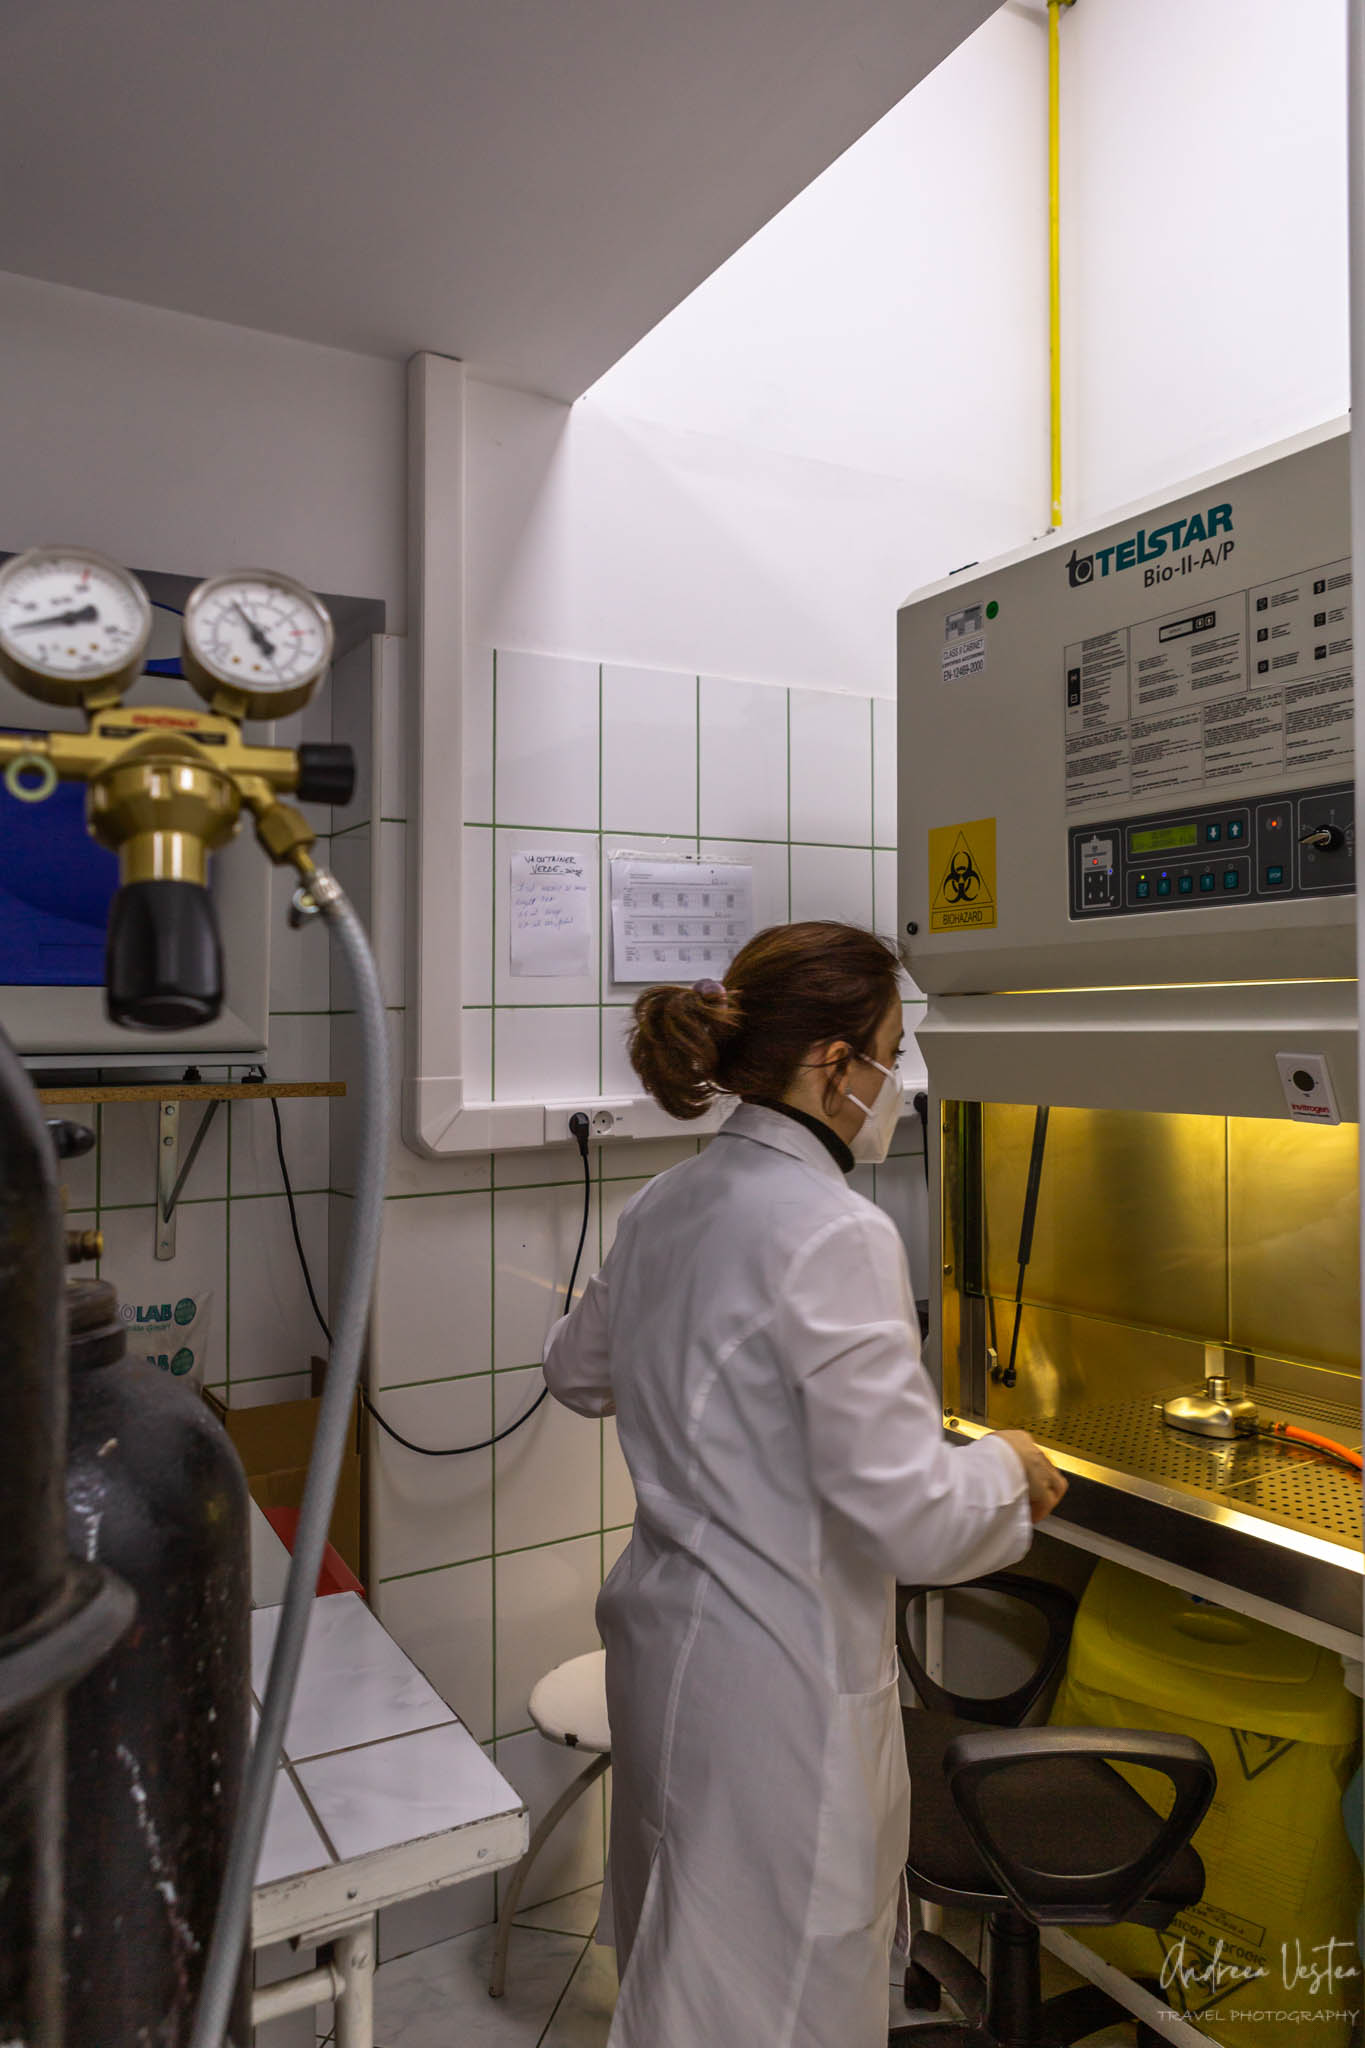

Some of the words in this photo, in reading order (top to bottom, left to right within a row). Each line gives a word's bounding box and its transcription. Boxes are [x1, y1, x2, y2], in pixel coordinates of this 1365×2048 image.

[1096, 504, 1234, 577] TELSTAR
[1144, 541, 1235, 588] Bio-II-A/P
[963, 639, 983, 653] CABINET
[943, 910, 983, 927] BIOHAZARD
[1291, 1104, 1330, 1113] invitrogen
